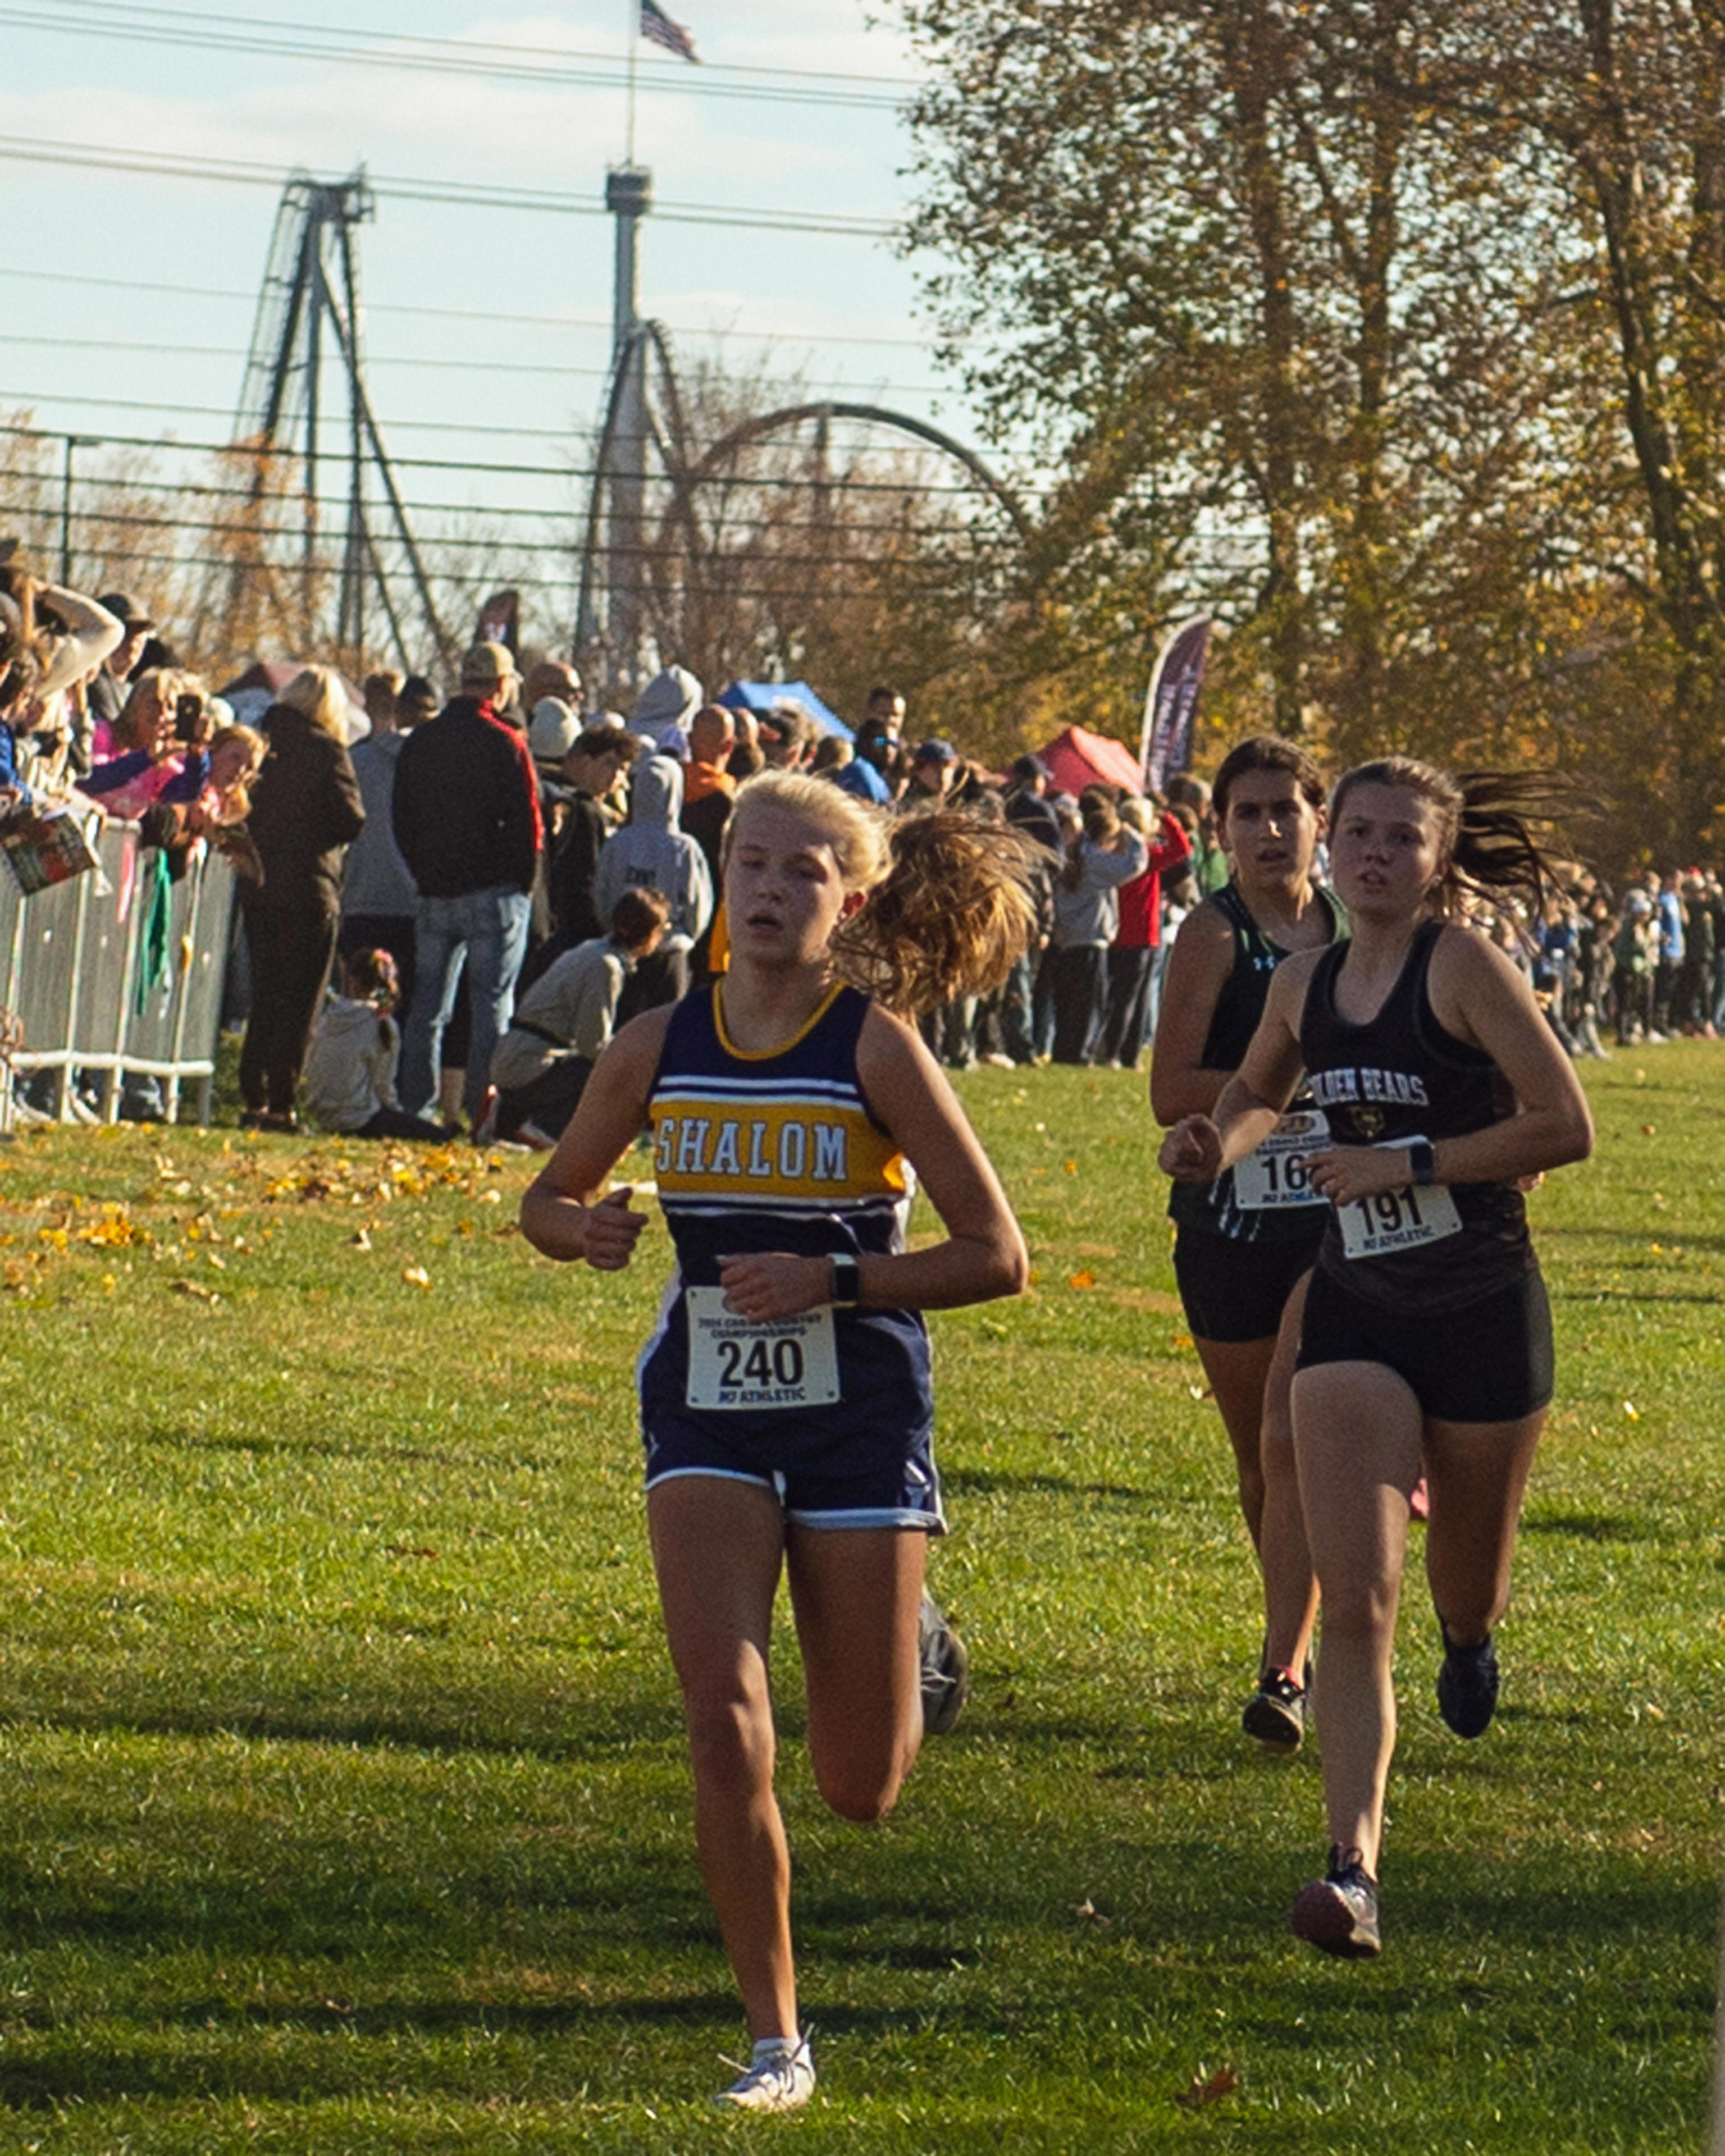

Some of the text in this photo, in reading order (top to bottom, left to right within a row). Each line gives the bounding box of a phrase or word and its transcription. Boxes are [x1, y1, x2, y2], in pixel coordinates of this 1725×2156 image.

[1361, 1068, 1430, 1106] BEARS
[656, 1118, 846, 1180] SHALOM
[1261, 1154, 1316, 1191] 16
[1356, 1186, 1422, 1235] 191
[717, 1339, 803, 1387] 240
